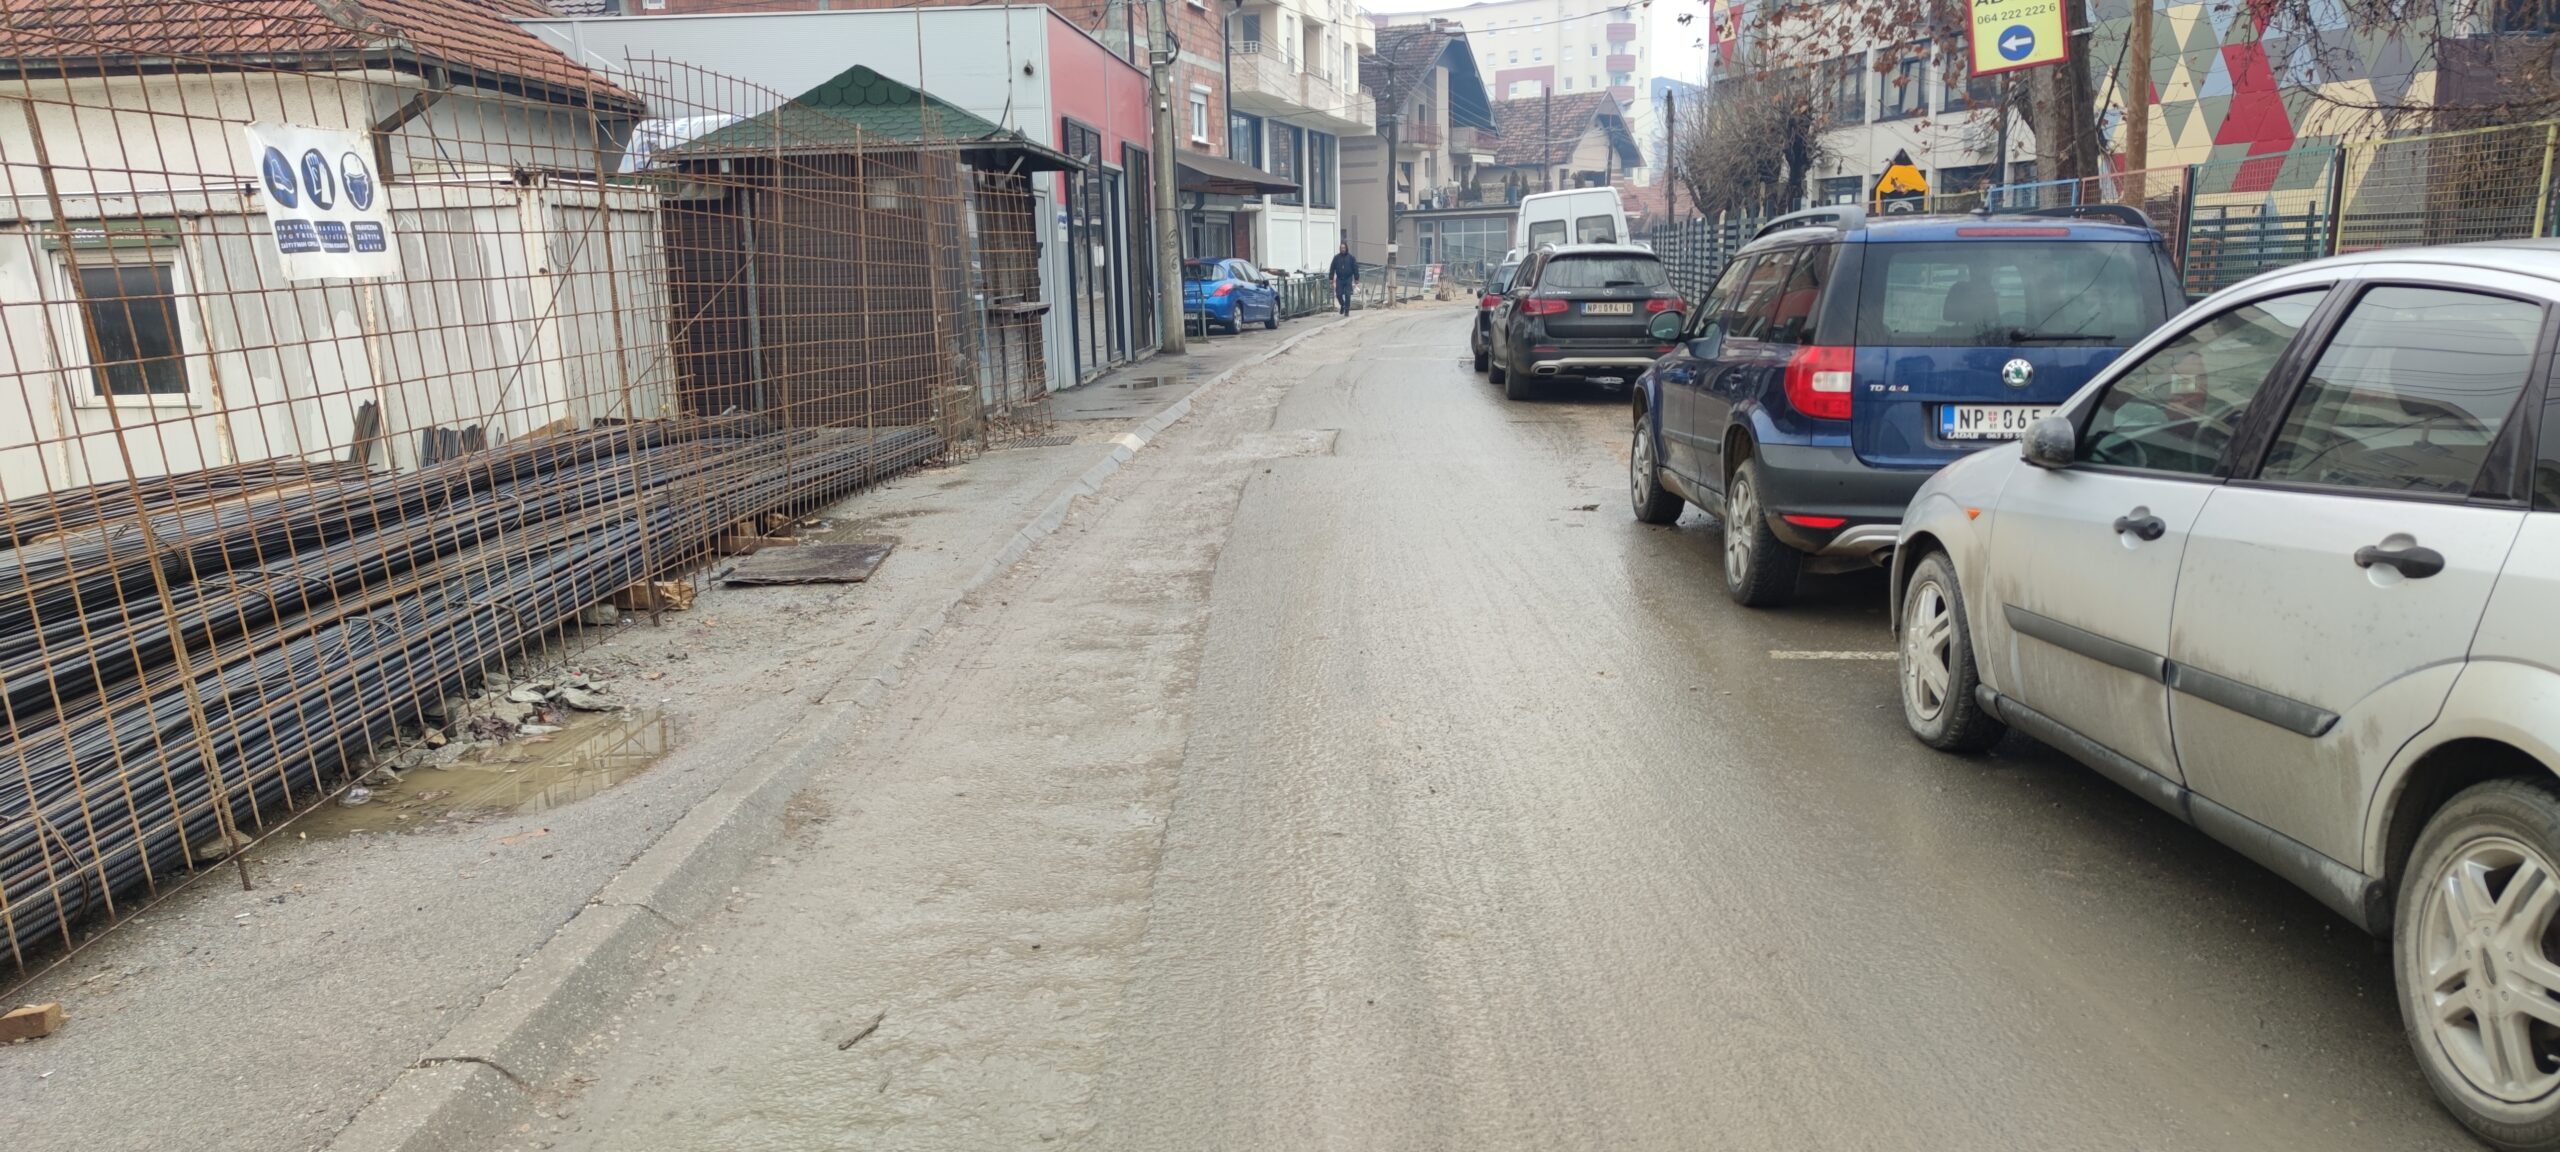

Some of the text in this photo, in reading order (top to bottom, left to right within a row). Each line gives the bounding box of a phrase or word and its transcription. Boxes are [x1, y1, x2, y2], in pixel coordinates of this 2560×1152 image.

[1977, 3, 2056, 24] 064 222 222 6
[1960, 409, 1984, 429] NP
